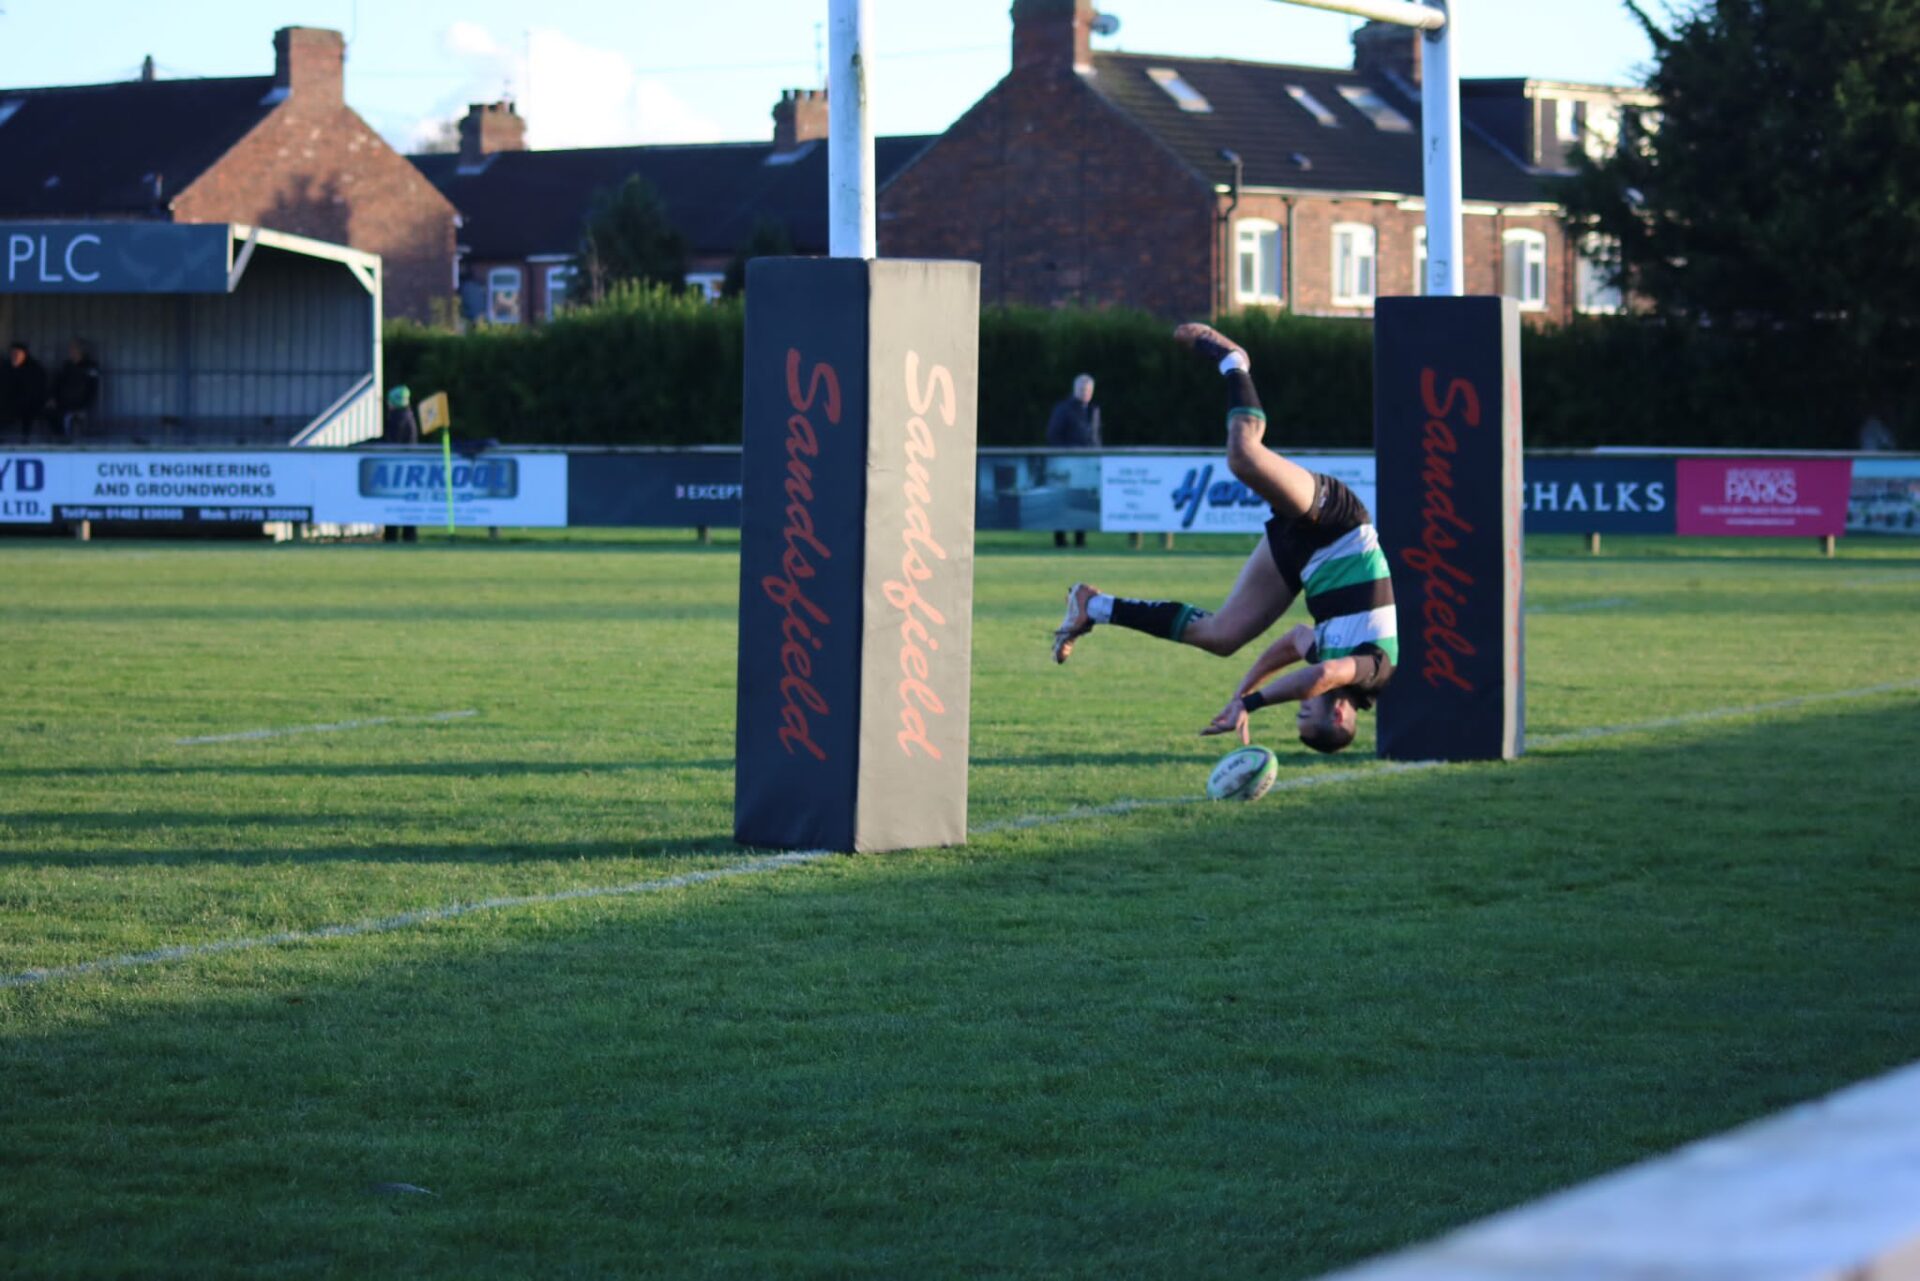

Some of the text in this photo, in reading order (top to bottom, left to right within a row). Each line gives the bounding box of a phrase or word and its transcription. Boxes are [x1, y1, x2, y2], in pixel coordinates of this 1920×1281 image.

[8, 234, 101, 283] PLC
[97, 463, 272, 477] CIVIL ENGINEERING
[369, 464, 509, 489] AIRKOOL
[94, 483, 276, 497] AND GROUNDWORKS
[1522, 481, 1666, 513] HALKS
[3, 500, 46, 516] LTD.
[1401, 367, 1481, 692] Sandsfield
[761, 347, 842, 761] Sandsfield
[882, 349, 957, 762] Sandsfield
